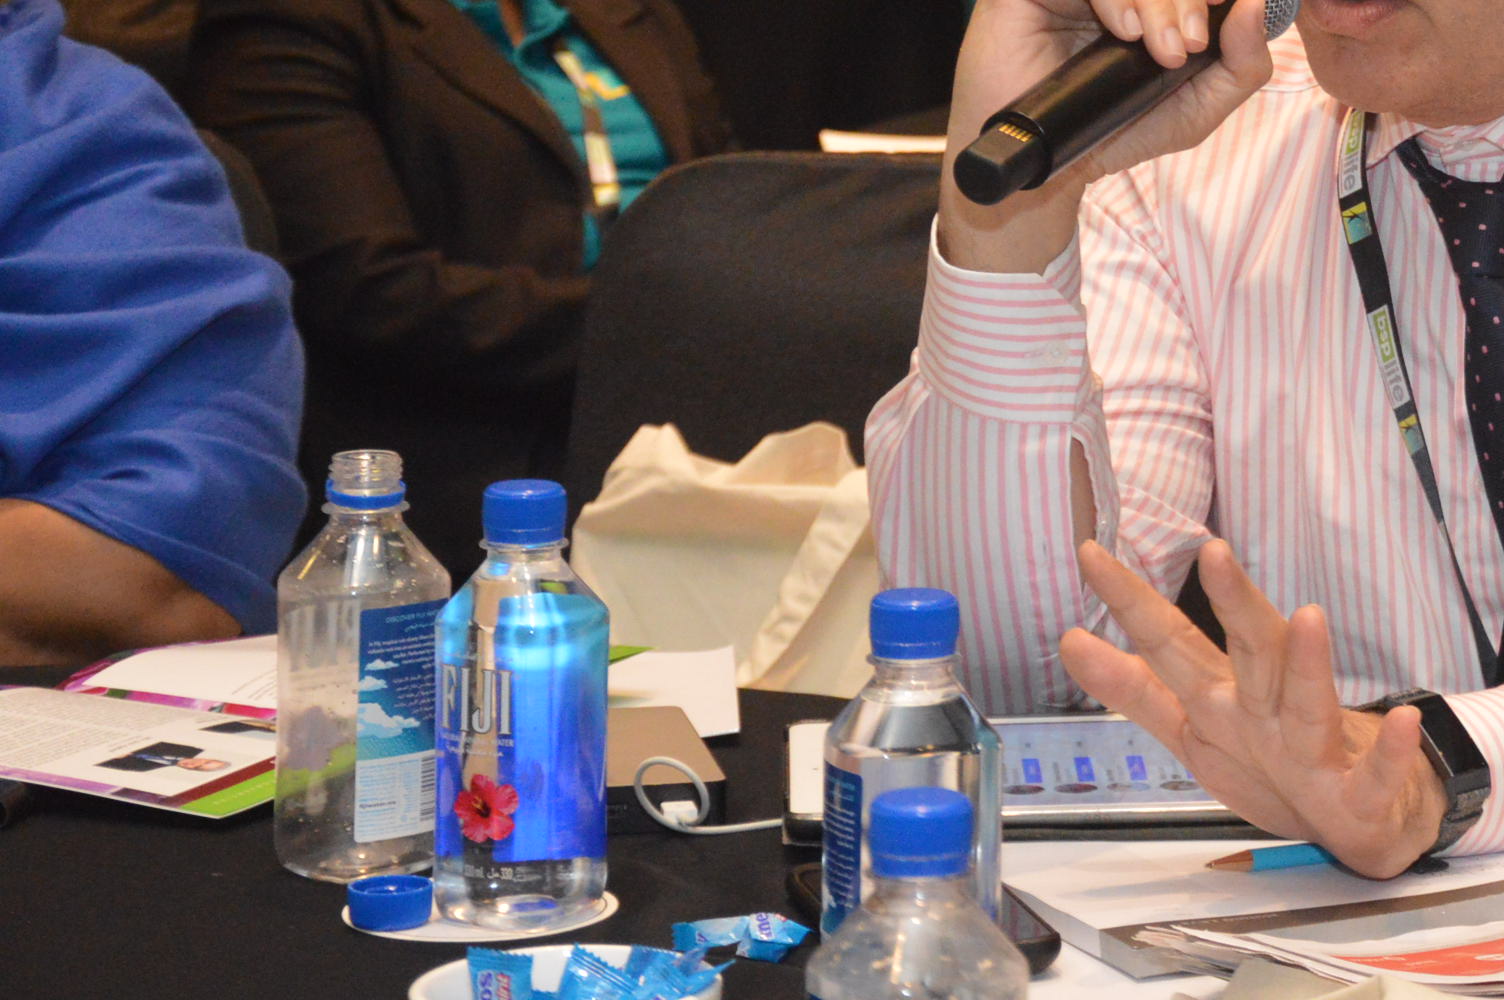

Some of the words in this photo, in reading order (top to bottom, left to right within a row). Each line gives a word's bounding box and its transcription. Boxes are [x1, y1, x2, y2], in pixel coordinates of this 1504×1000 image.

[1343, 151, 1359, 191] life
[1377, 315, 1391, 356] bsp
[1383, 360, 1404, 402] life
[442, 664, 513, 734] FIJI
